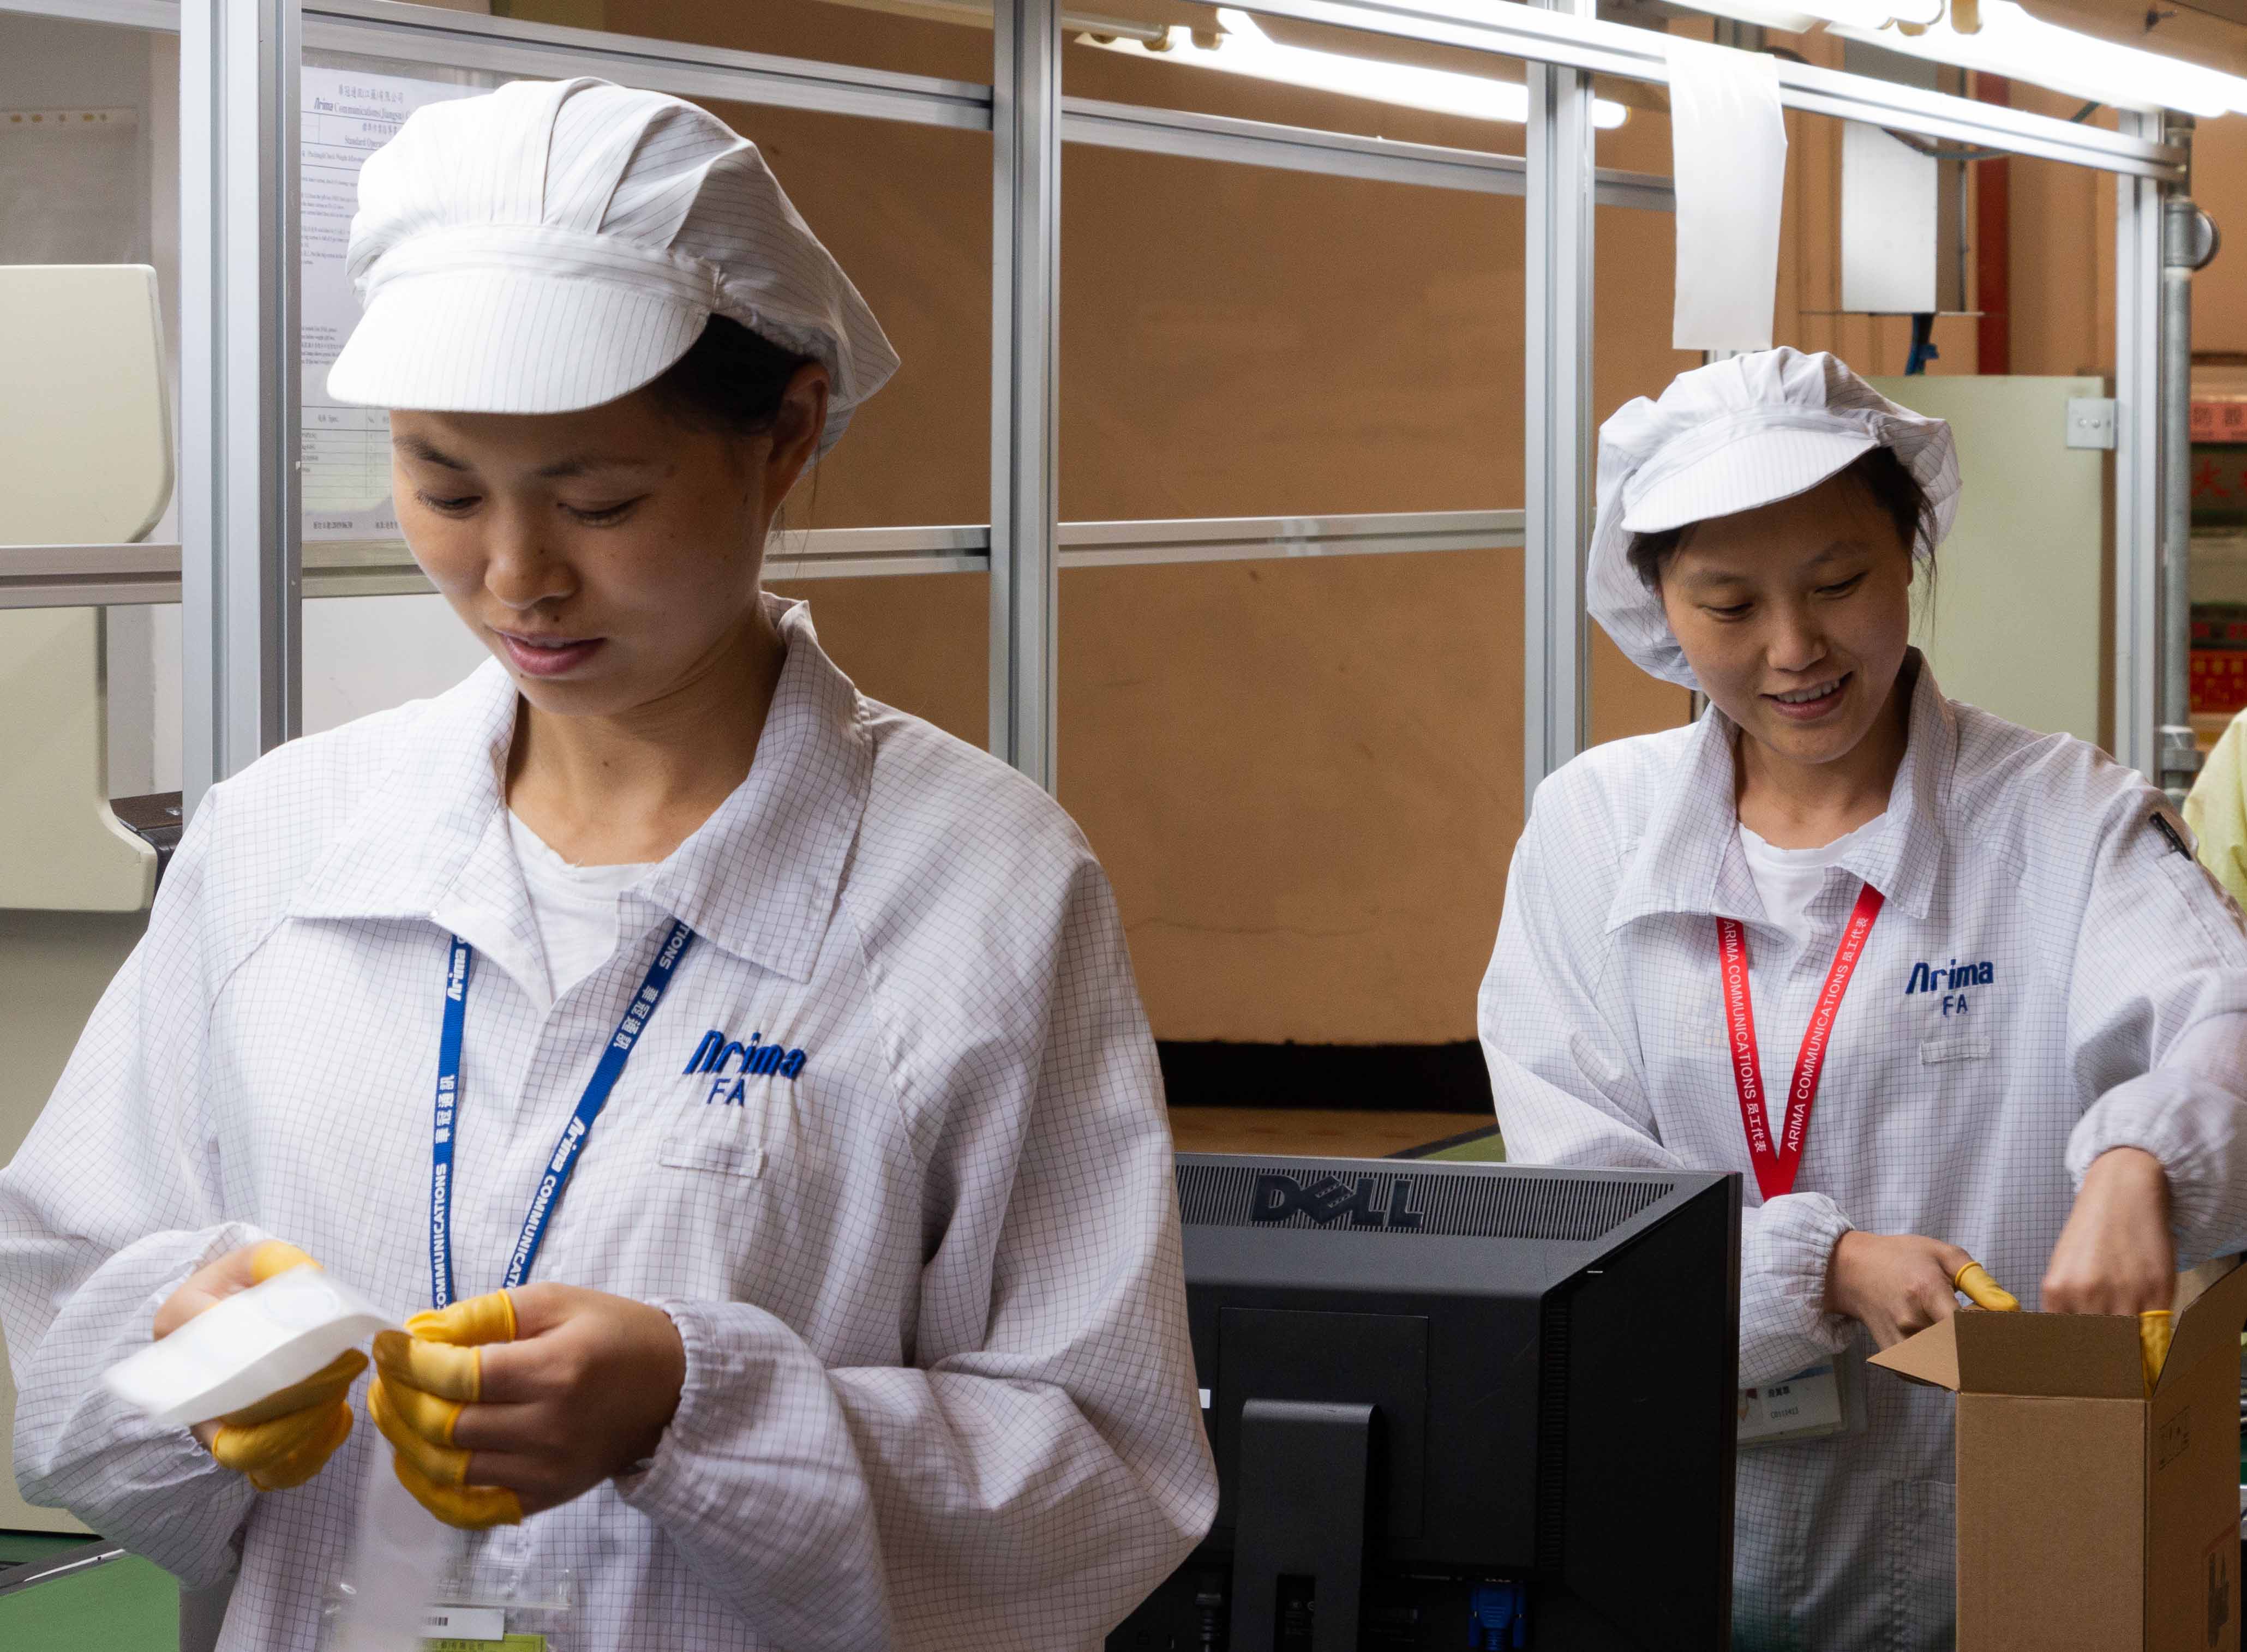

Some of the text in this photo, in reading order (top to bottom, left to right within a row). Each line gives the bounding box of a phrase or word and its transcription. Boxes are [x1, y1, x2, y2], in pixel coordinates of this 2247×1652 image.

[447, 948, 466, 1001] Arima
[1905, 959, 1994, 995] Arima
[1943, 994, 1968, 1016] FA
[682, 1029, 807, 1080] Arima
[1724, 920, 1766, 1153] ARIMA COMMUNICATIONS 员工代表
[1787, 917, 1868, 1152] ARIMA COMMUNICATIONS 员工代表
[706, 1078, 745, 1107] FA
[551, 1116, 585, 1173] Arima
[1250, 1174, 1424, 1229] DELL
